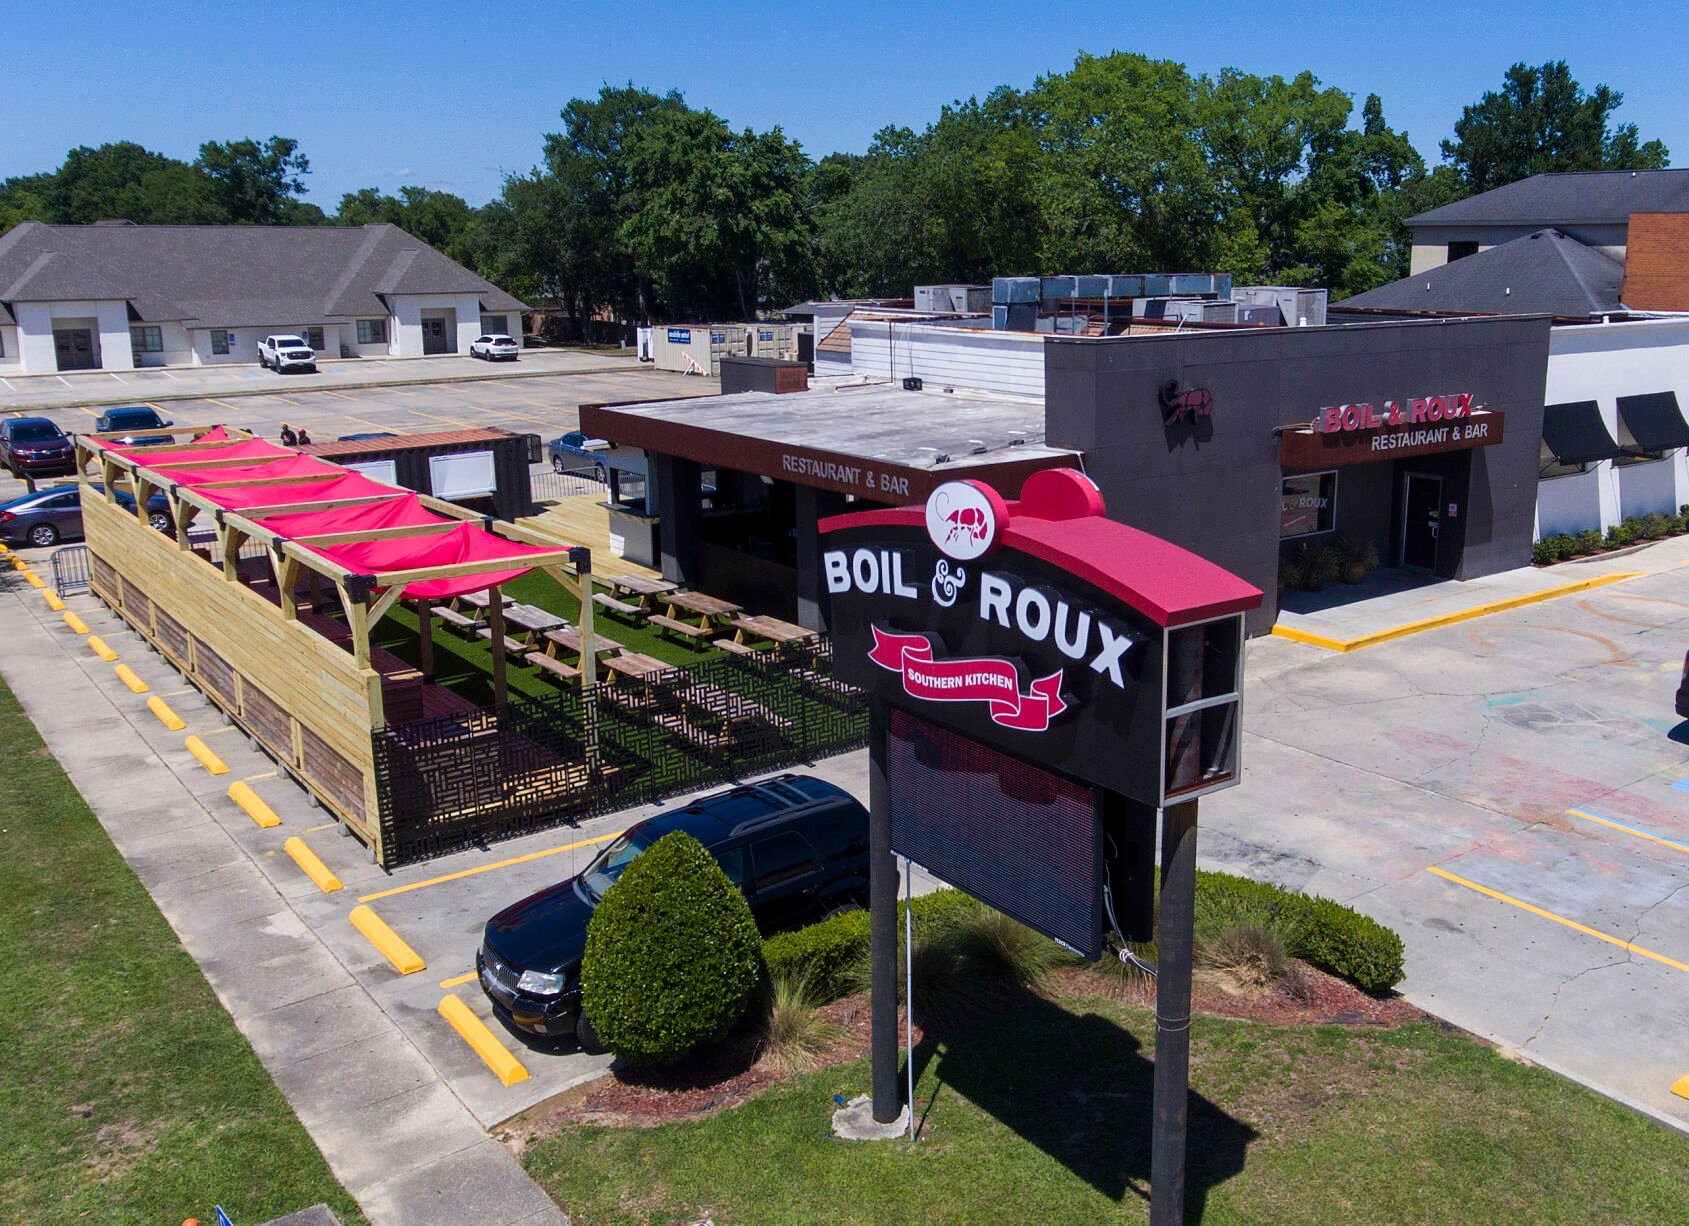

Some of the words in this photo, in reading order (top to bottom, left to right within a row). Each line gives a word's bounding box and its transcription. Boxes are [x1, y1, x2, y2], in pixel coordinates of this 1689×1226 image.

[1321, 403, 1382, 433] BOIL
[1384, 401, 1400, 425] &
[1408, 393, 1474, 423] ROUX
[1372, 427, 1449, 451] RESTAURANT
[1452, 426, 1461, 441] &
[1465, 423, 1489, 439] BAR
[782, 454, 861, 485] RESTAURANT
[866, 471, 875, 488] &
[880, 473, 909, 496] BAR
[1299, 496, 1328, 509] ROUX
[823, 548, 918, 599] BOIL
[931, 558, 966, 607] &
[979, 570, 1133, 689] ROUX
[907, 668, 963, 689] SOUTHERN
[965, 673, 1013, 691] KITCHEN
